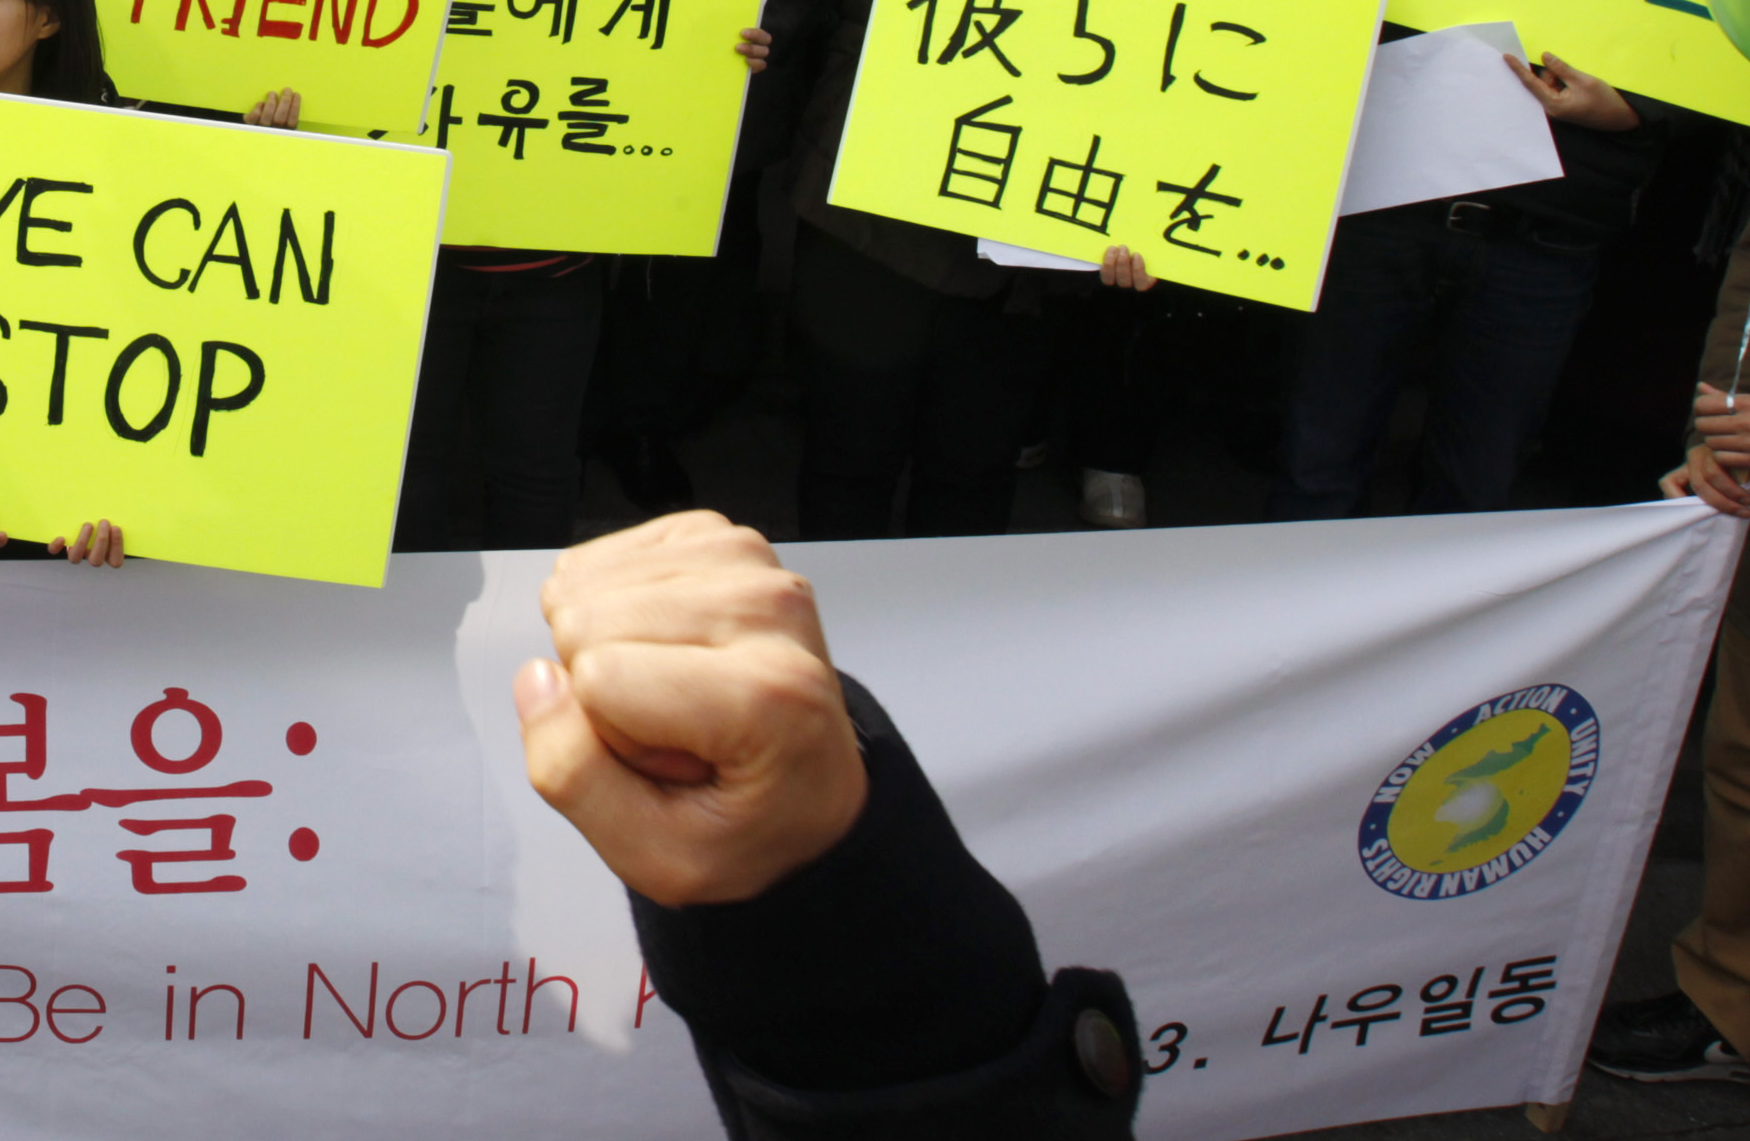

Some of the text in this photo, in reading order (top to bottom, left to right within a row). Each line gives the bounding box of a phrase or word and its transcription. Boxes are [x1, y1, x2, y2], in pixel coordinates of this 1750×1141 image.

[132, 197, 336, 306] CAN
[1472, 685, 1569, 727] ACTION
[1373, 741, 1437, 804] NOW
[1561, 717, 1599, 796] UNITY
[1361, 825, 1553, 899] HUMAN RIGHTS
[164, 964, 247, 1043] in
[303, 956, 581, 1041] North
[1260, 954, 1559, 1056] 나우일동
